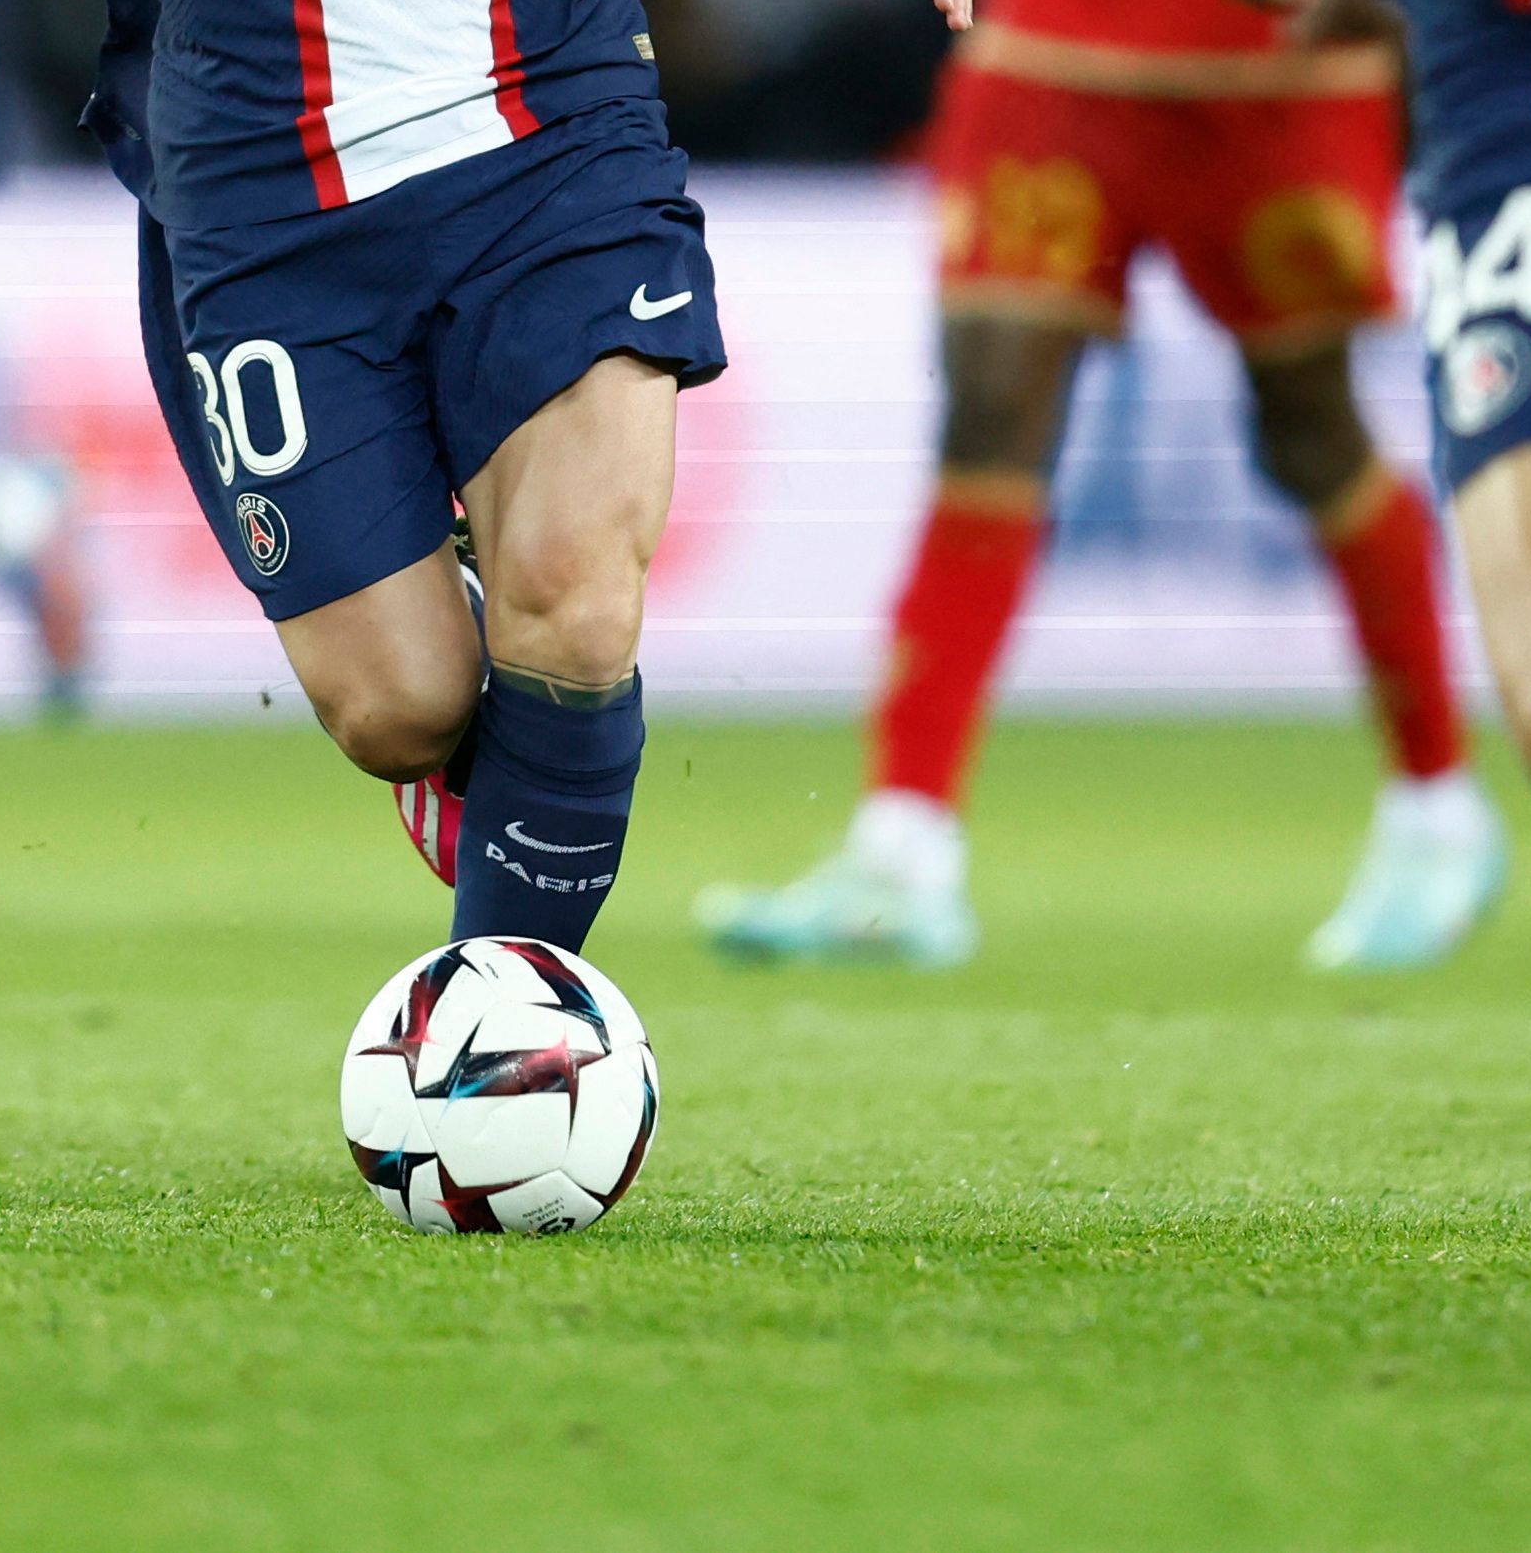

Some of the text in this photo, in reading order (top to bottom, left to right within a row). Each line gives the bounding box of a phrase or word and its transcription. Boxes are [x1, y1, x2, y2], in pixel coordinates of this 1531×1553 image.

[186, 339, 309, 487] 30
[237, 497, 266, 520] PARIS
[485, 841, 614, 893] PARIS
